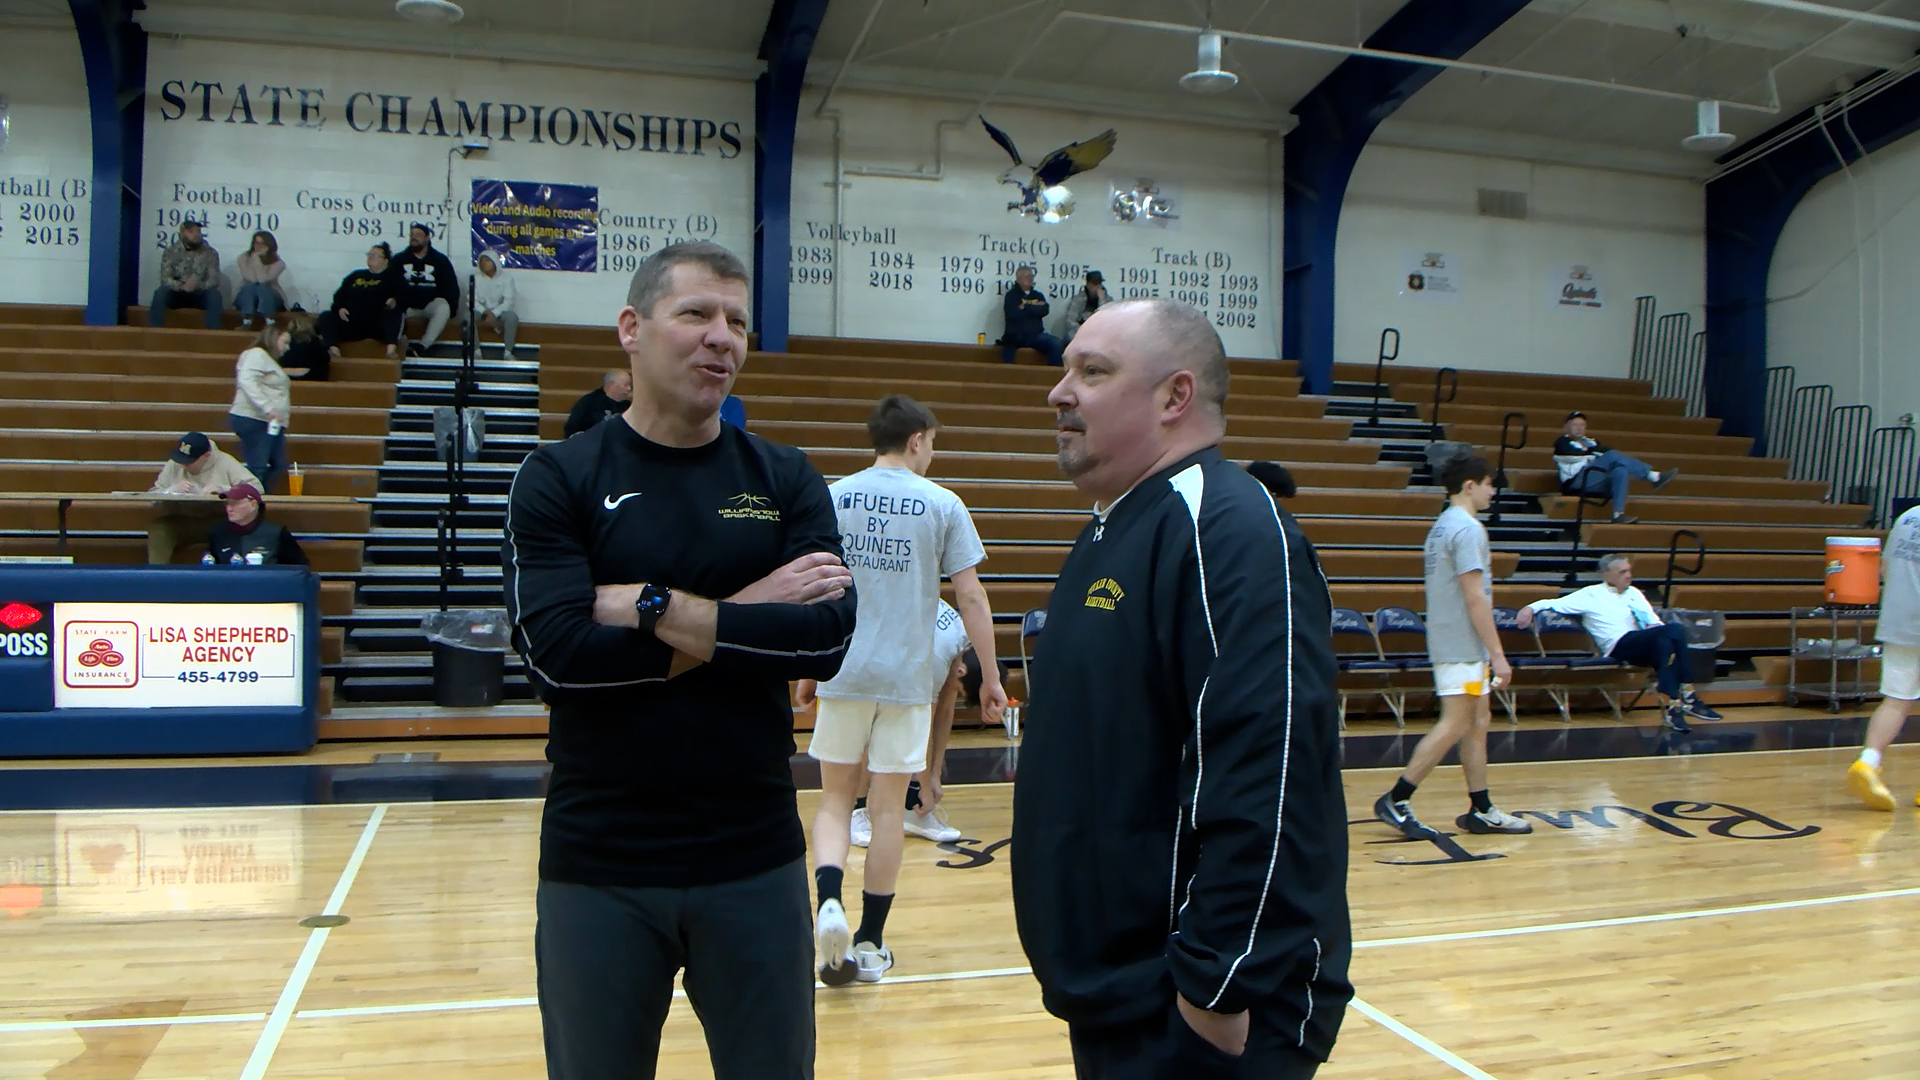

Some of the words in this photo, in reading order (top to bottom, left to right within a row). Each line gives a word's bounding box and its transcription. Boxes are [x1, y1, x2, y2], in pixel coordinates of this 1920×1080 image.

[160, 80, 327, 131] STATE
[345, 91, 742, 160] CHAMPIONSHIPS
[173, 183, 262, 206] Football
[20, 202, 76, 223] 2000
[296, 190, 354, 212] Cross
[362, 193, 445, 221] Country
[472, 202, 500, 216] Video
[502, 203, 521, 217] and
[522, 204, 551, 218] Audio
[553, 207, 599, 224] recording
[226, 211, 280, 231] 2010
[331, 216, 383, 237] 1983
[600, 208, 677, 235] Country
[686, 212, 718, 238] (B)
[26, 226, 80, 246] 2015
[486, 224, 518, 238] during
[520, 226, 532, 236] all
[534, 227, 564, 239] games
[566, 227, 584, 239] and
[807, 221, 896, 246] Volleyball
[515, 243, 556, 256] matches
[600, 233, 650, 253] 1986
[979, 233, 1060, 261] Track(G)
[870, 250, 915, 270] 1984
[940, 255, 984, 275] 1979
[1152, 246, 1198, 266] Track
[1205, 251, 1232, 273] (B)
[869, 270, 913, 291] 2018
[941, 276, 985, 295] 1996
[1119, 266, 1158, 285] 1991
[1170, 270, 1210, 289] 1992
[1220, 274, 1259, 292] 1993
[1219, 293, 1258, 310] 1999
[1216, 311, 1257, 329] 2002
[853, 492, 926, 517] FUELED
[867, 516, 890, 535] BY
[845, 533, 912, 557] QUINETS
[149, 627, 187, 643] LISA
[193, 627, 289, 643] SHEPHERD
[182, 646, 256, 663] AGENCY
[74, 671, 128, 679] INSURANCE
[177, 671, 259, 684] 455-4799
